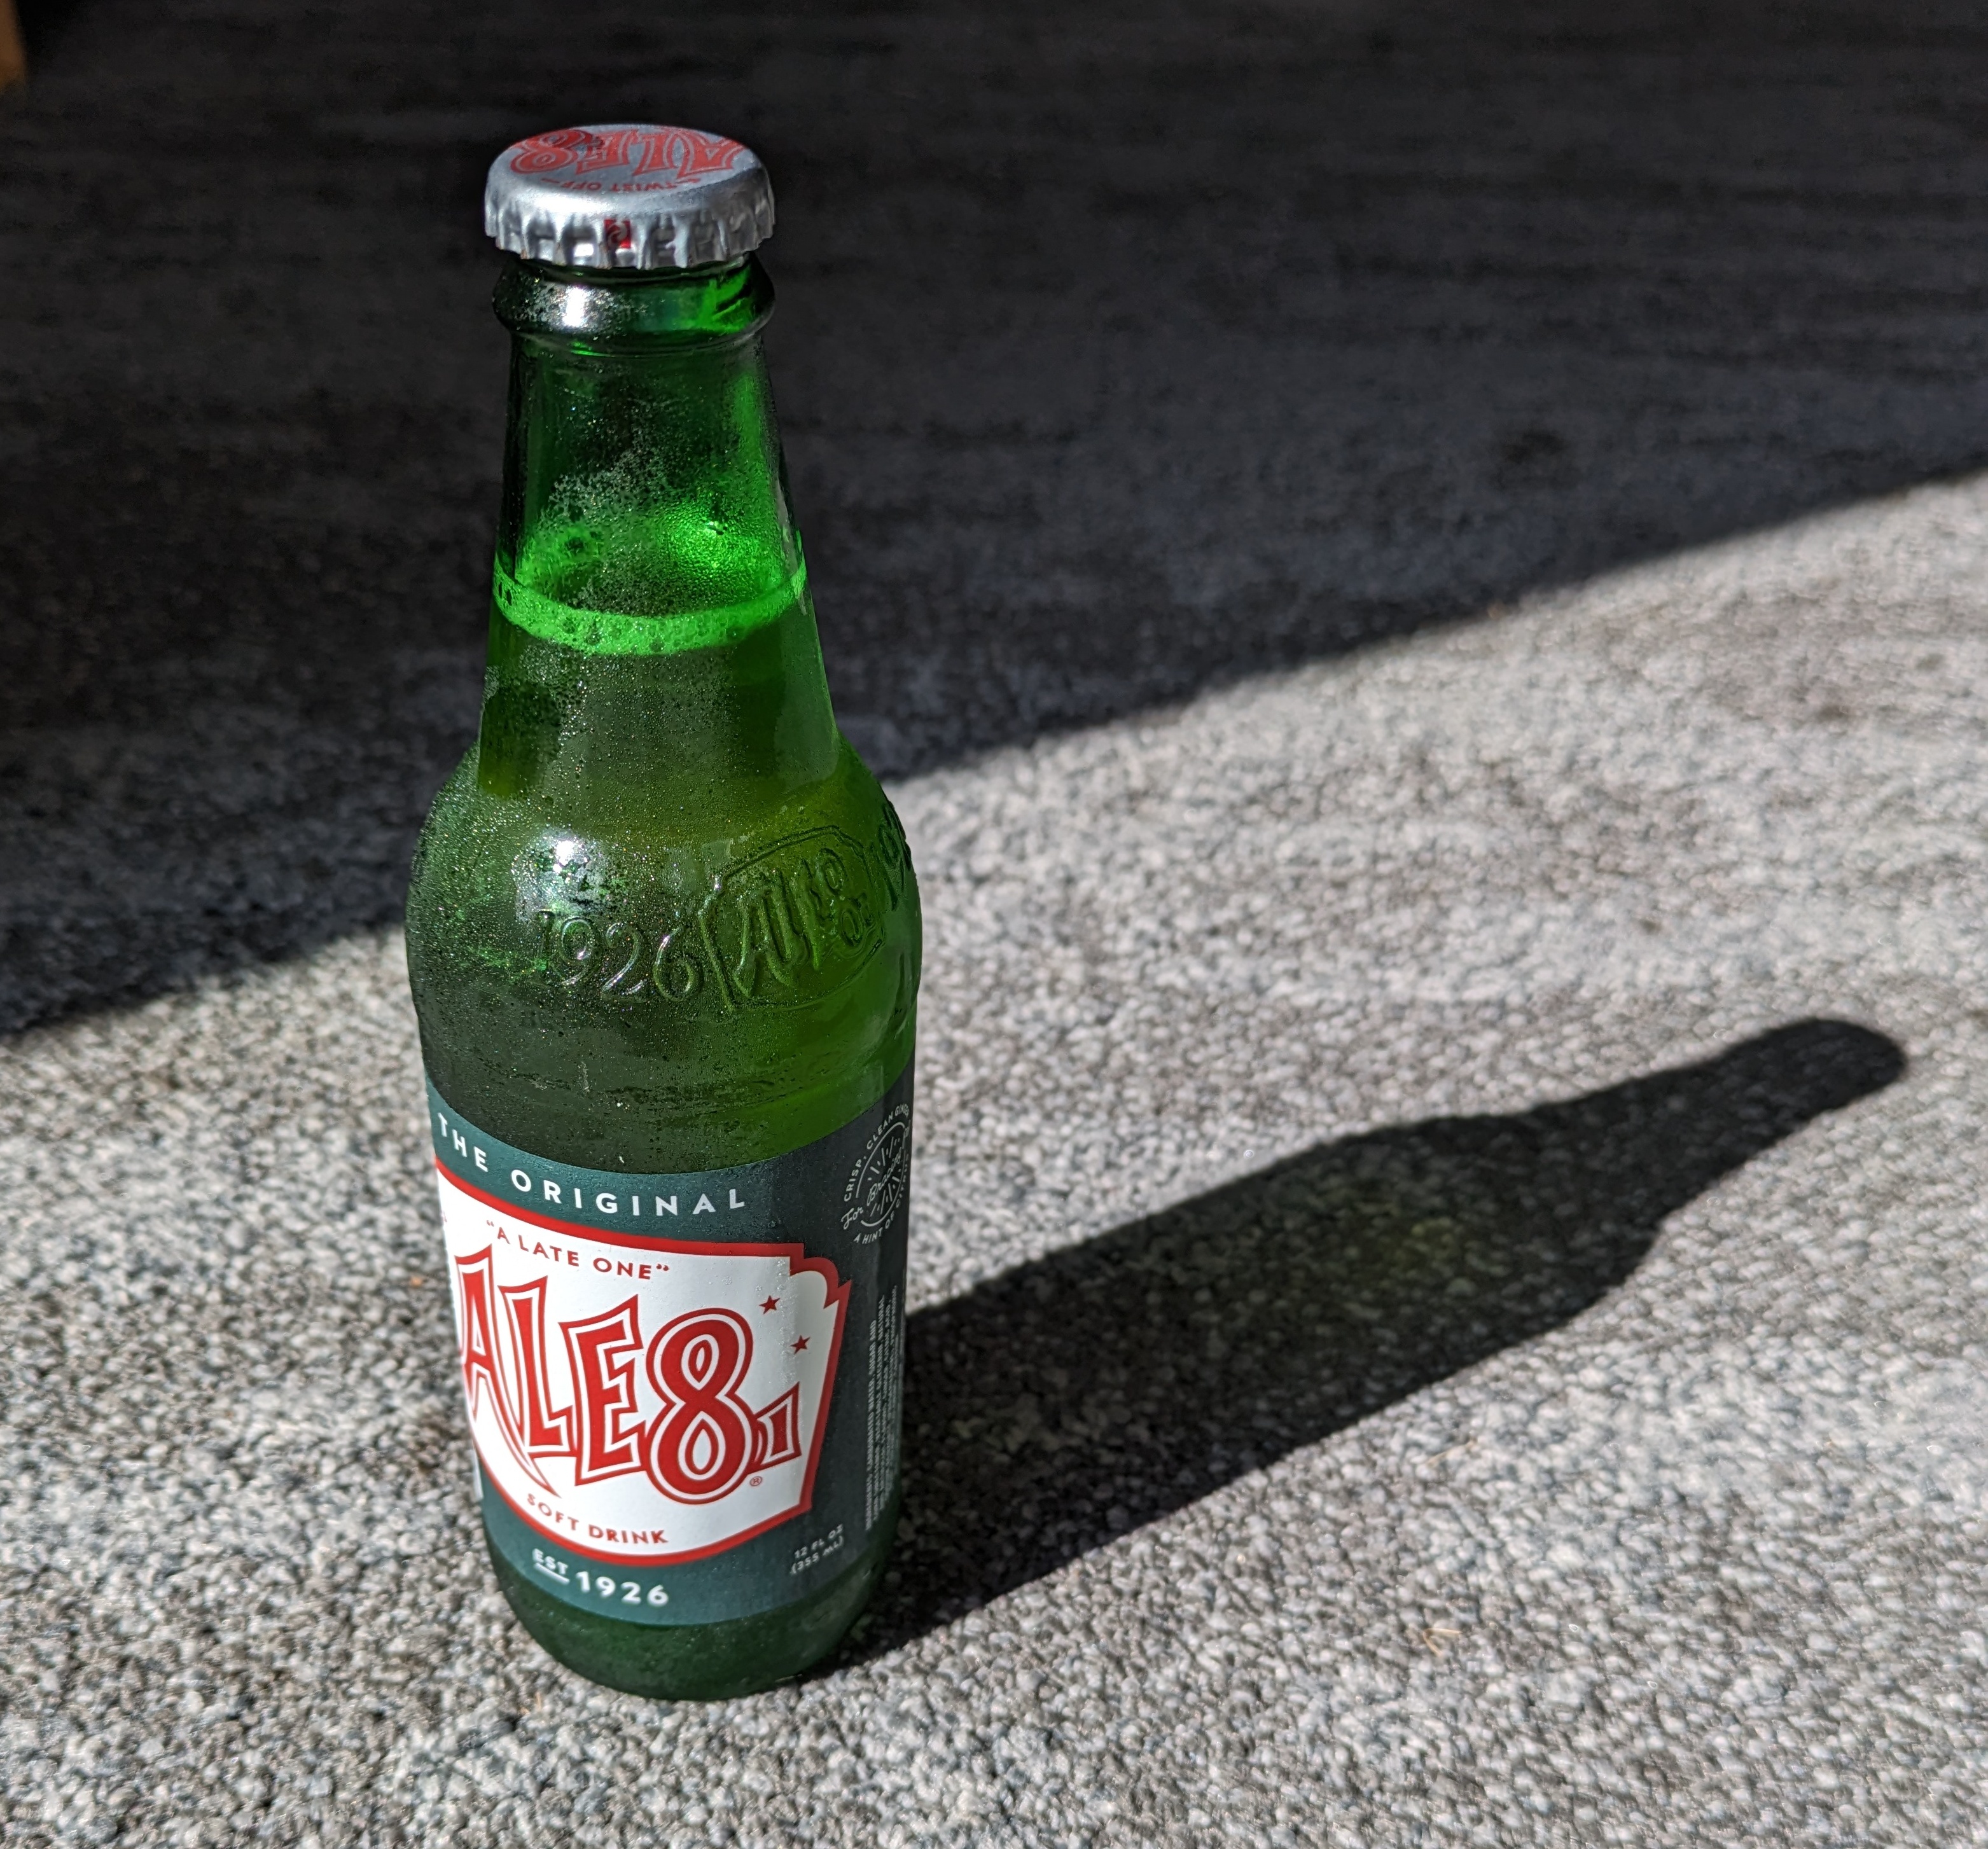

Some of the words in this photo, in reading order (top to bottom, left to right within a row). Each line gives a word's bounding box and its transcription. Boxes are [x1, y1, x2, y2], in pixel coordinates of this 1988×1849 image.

[560, 180, 602, 191] OFF
[611, 181, 677, 193] TWIST
[541, 910, 700, 1004] 1926
[866, 1111, 893, 1150] CLEAN
[438, 1112, 489, 1172] THE
[511, 1169, 745, 1216] ORIGINAL
[853, 1233, 860, 1243] A
[862, 1228, 883, 1244] HINT
[885, 1210, 894, 1229] OF
[518, 1235, 580, 1267] LATE
[527, 1493, 580, 1530] SOFT
[588, 1524, 669, 1544] DRINK
[795, 1546, 808, 1559] 12
[811, 1538, 825, 1550] FL
[828, 1523, 843, 1539] OZ
[532, 1548, 568, 1575] EST
[576, 1571, 669, 1607] 1926
[790, 1552, 820, 1574] (355
